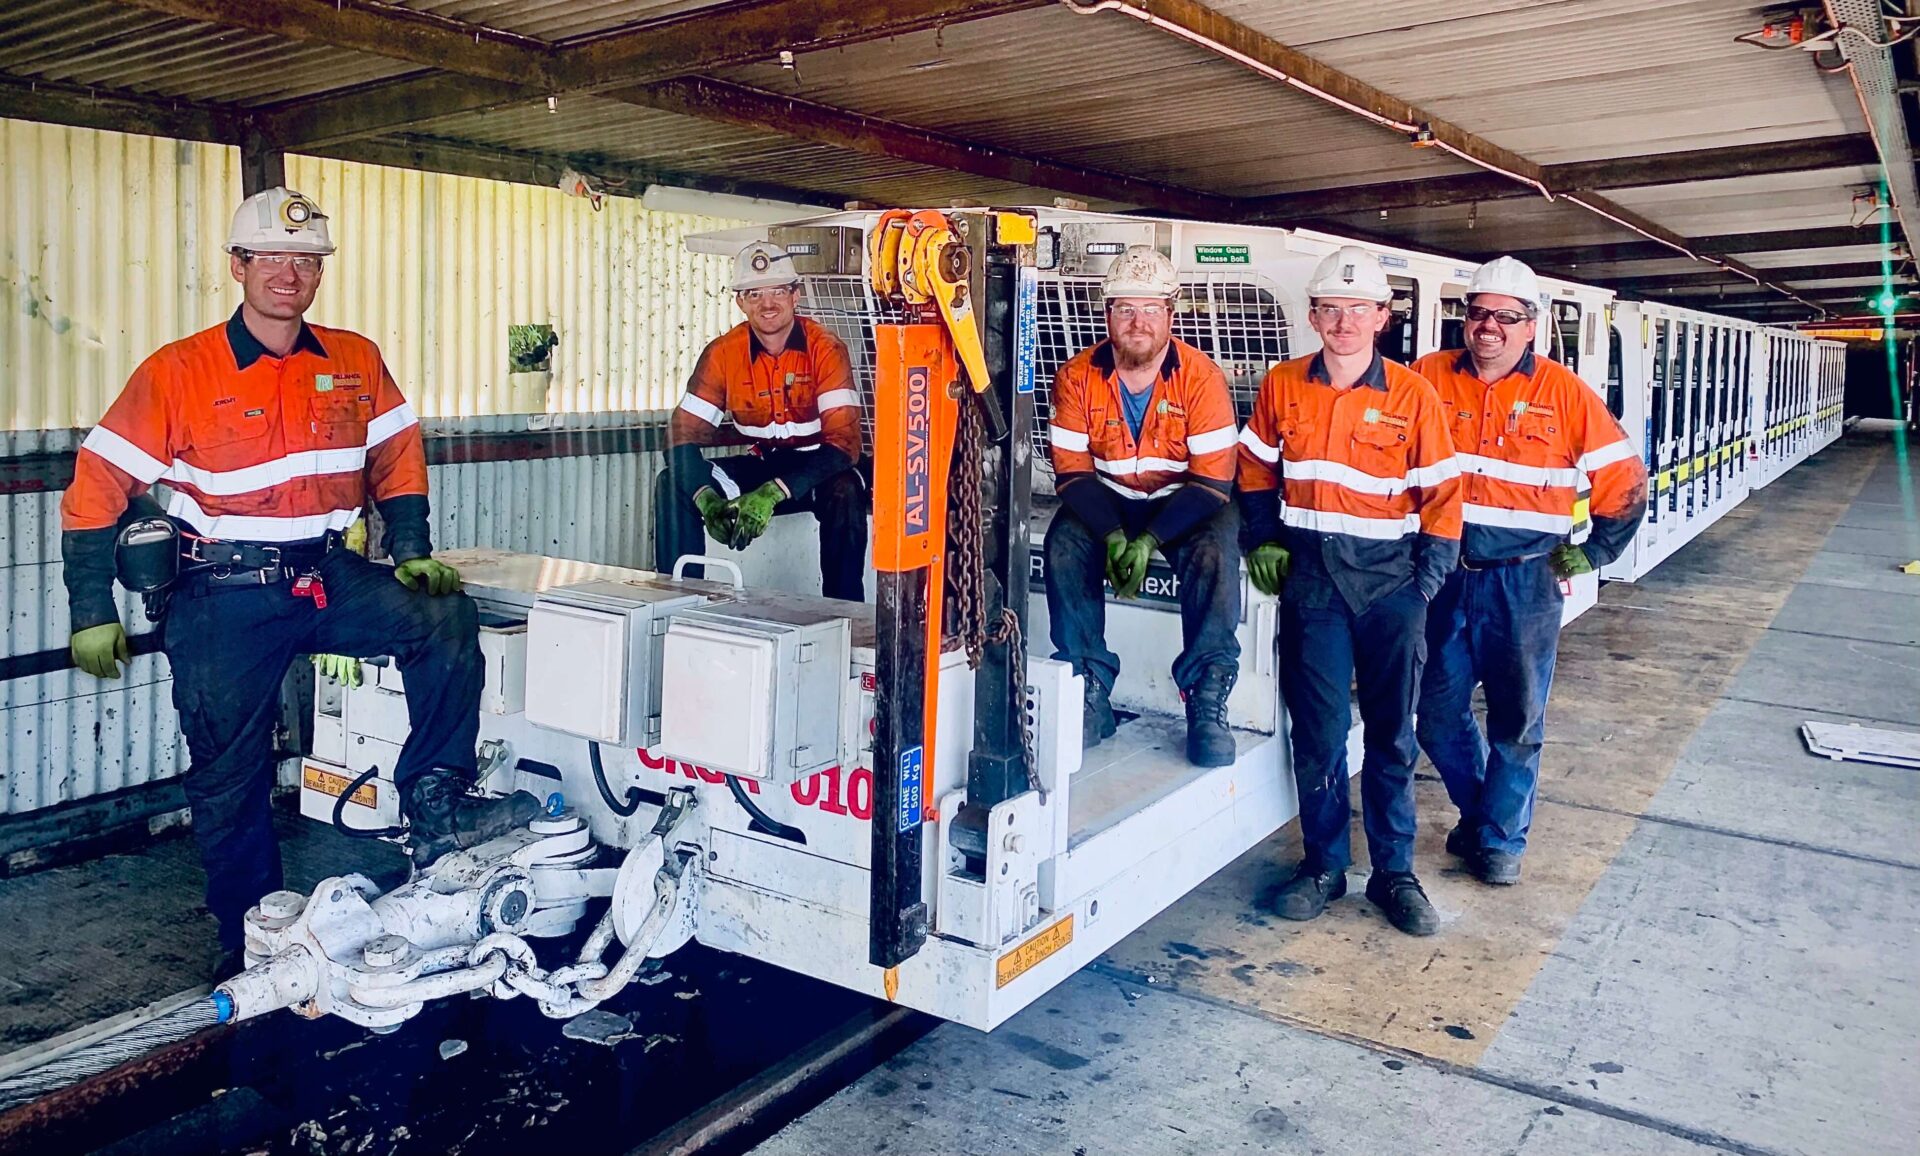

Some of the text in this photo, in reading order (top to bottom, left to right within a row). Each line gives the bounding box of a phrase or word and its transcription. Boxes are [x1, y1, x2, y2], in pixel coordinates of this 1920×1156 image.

[1197, 246, 1247, 254] Window Guard
[1200, 255, 1245, 263] Release Bolt
[1025, 348, 1029, 360] BE
[906, 373, 926, 527] AL-SV500
[901, 753, 911, 826] CRANE WLL
[911, 763, 920, 809] 500 Kg
[1025, 935, 1050, 955] CAUTION
[999, 962, 1022, 985] BEWARE
[1025, 955, 1033, 968] OF
[1034, 945, 1052, 962] PINCH
